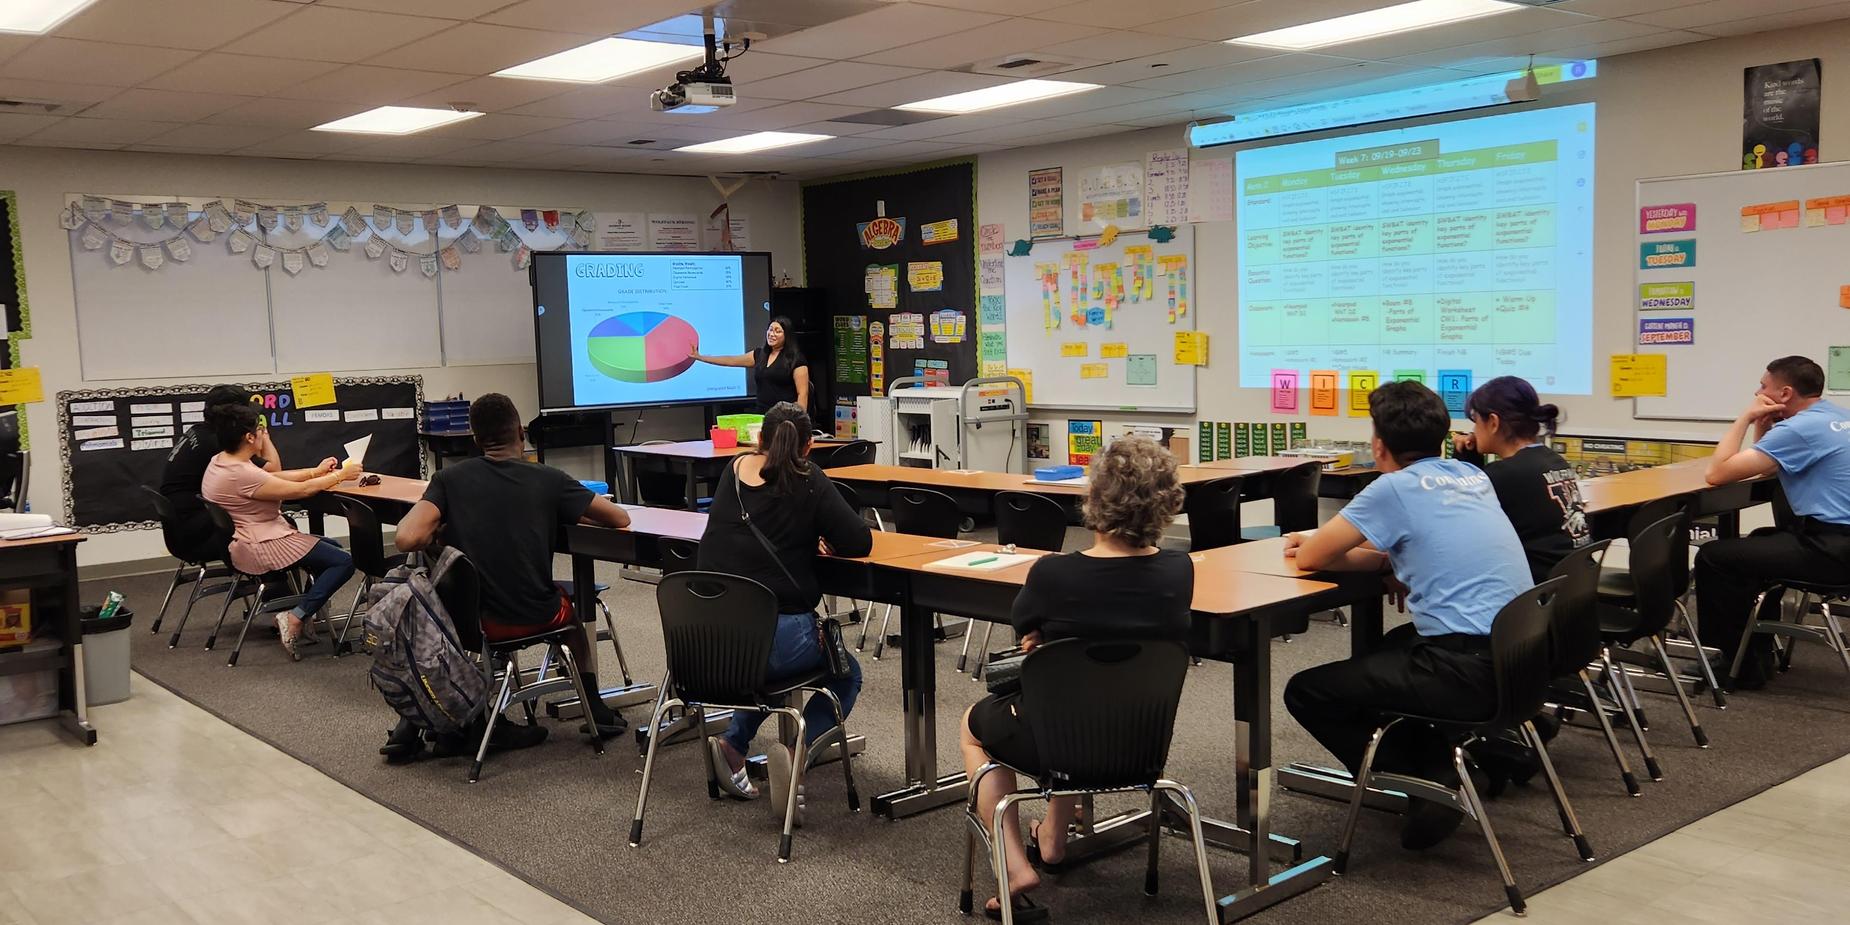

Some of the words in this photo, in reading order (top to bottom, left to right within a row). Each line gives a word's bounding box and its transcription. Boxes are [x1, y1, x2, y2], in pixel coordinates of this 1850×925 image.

[1338, 156, 1358, 164] Week
[1360, 153, 1369, 161] 7:
[1371, 146, 1422, 160] 09/19-09/23
[1496, 151, 1526, 162] Friday
[1438, 157, 1476, 168] Thursday
[1382, 164, 1426, 175] Wednesday
[1282, 177, 1308, 186] Monday
[1330, 171, 1360, 181] Tuesday
[864, 220, 900, 244] ALGEBRA
[1648, 254, 1686, 265] TUESDAY
[576, 262, 644, 278] GRADING
[1642, 298, 1690, 307] WEDNESDAY
[1642, 332, 1690, 342] SEPTEMBER
[1280, 380, 1290, 389] W
[1360, 379, 1367, 389] C
[1452, 379, 1459, 389] R
[250, 394, 290, 408] ORD
[258, 412, 293, 426] ALL
[1071, 422, 1093, 434] Today
[1076, 436, 1100, 446] great
[1082, 444, 1093, 453] day
